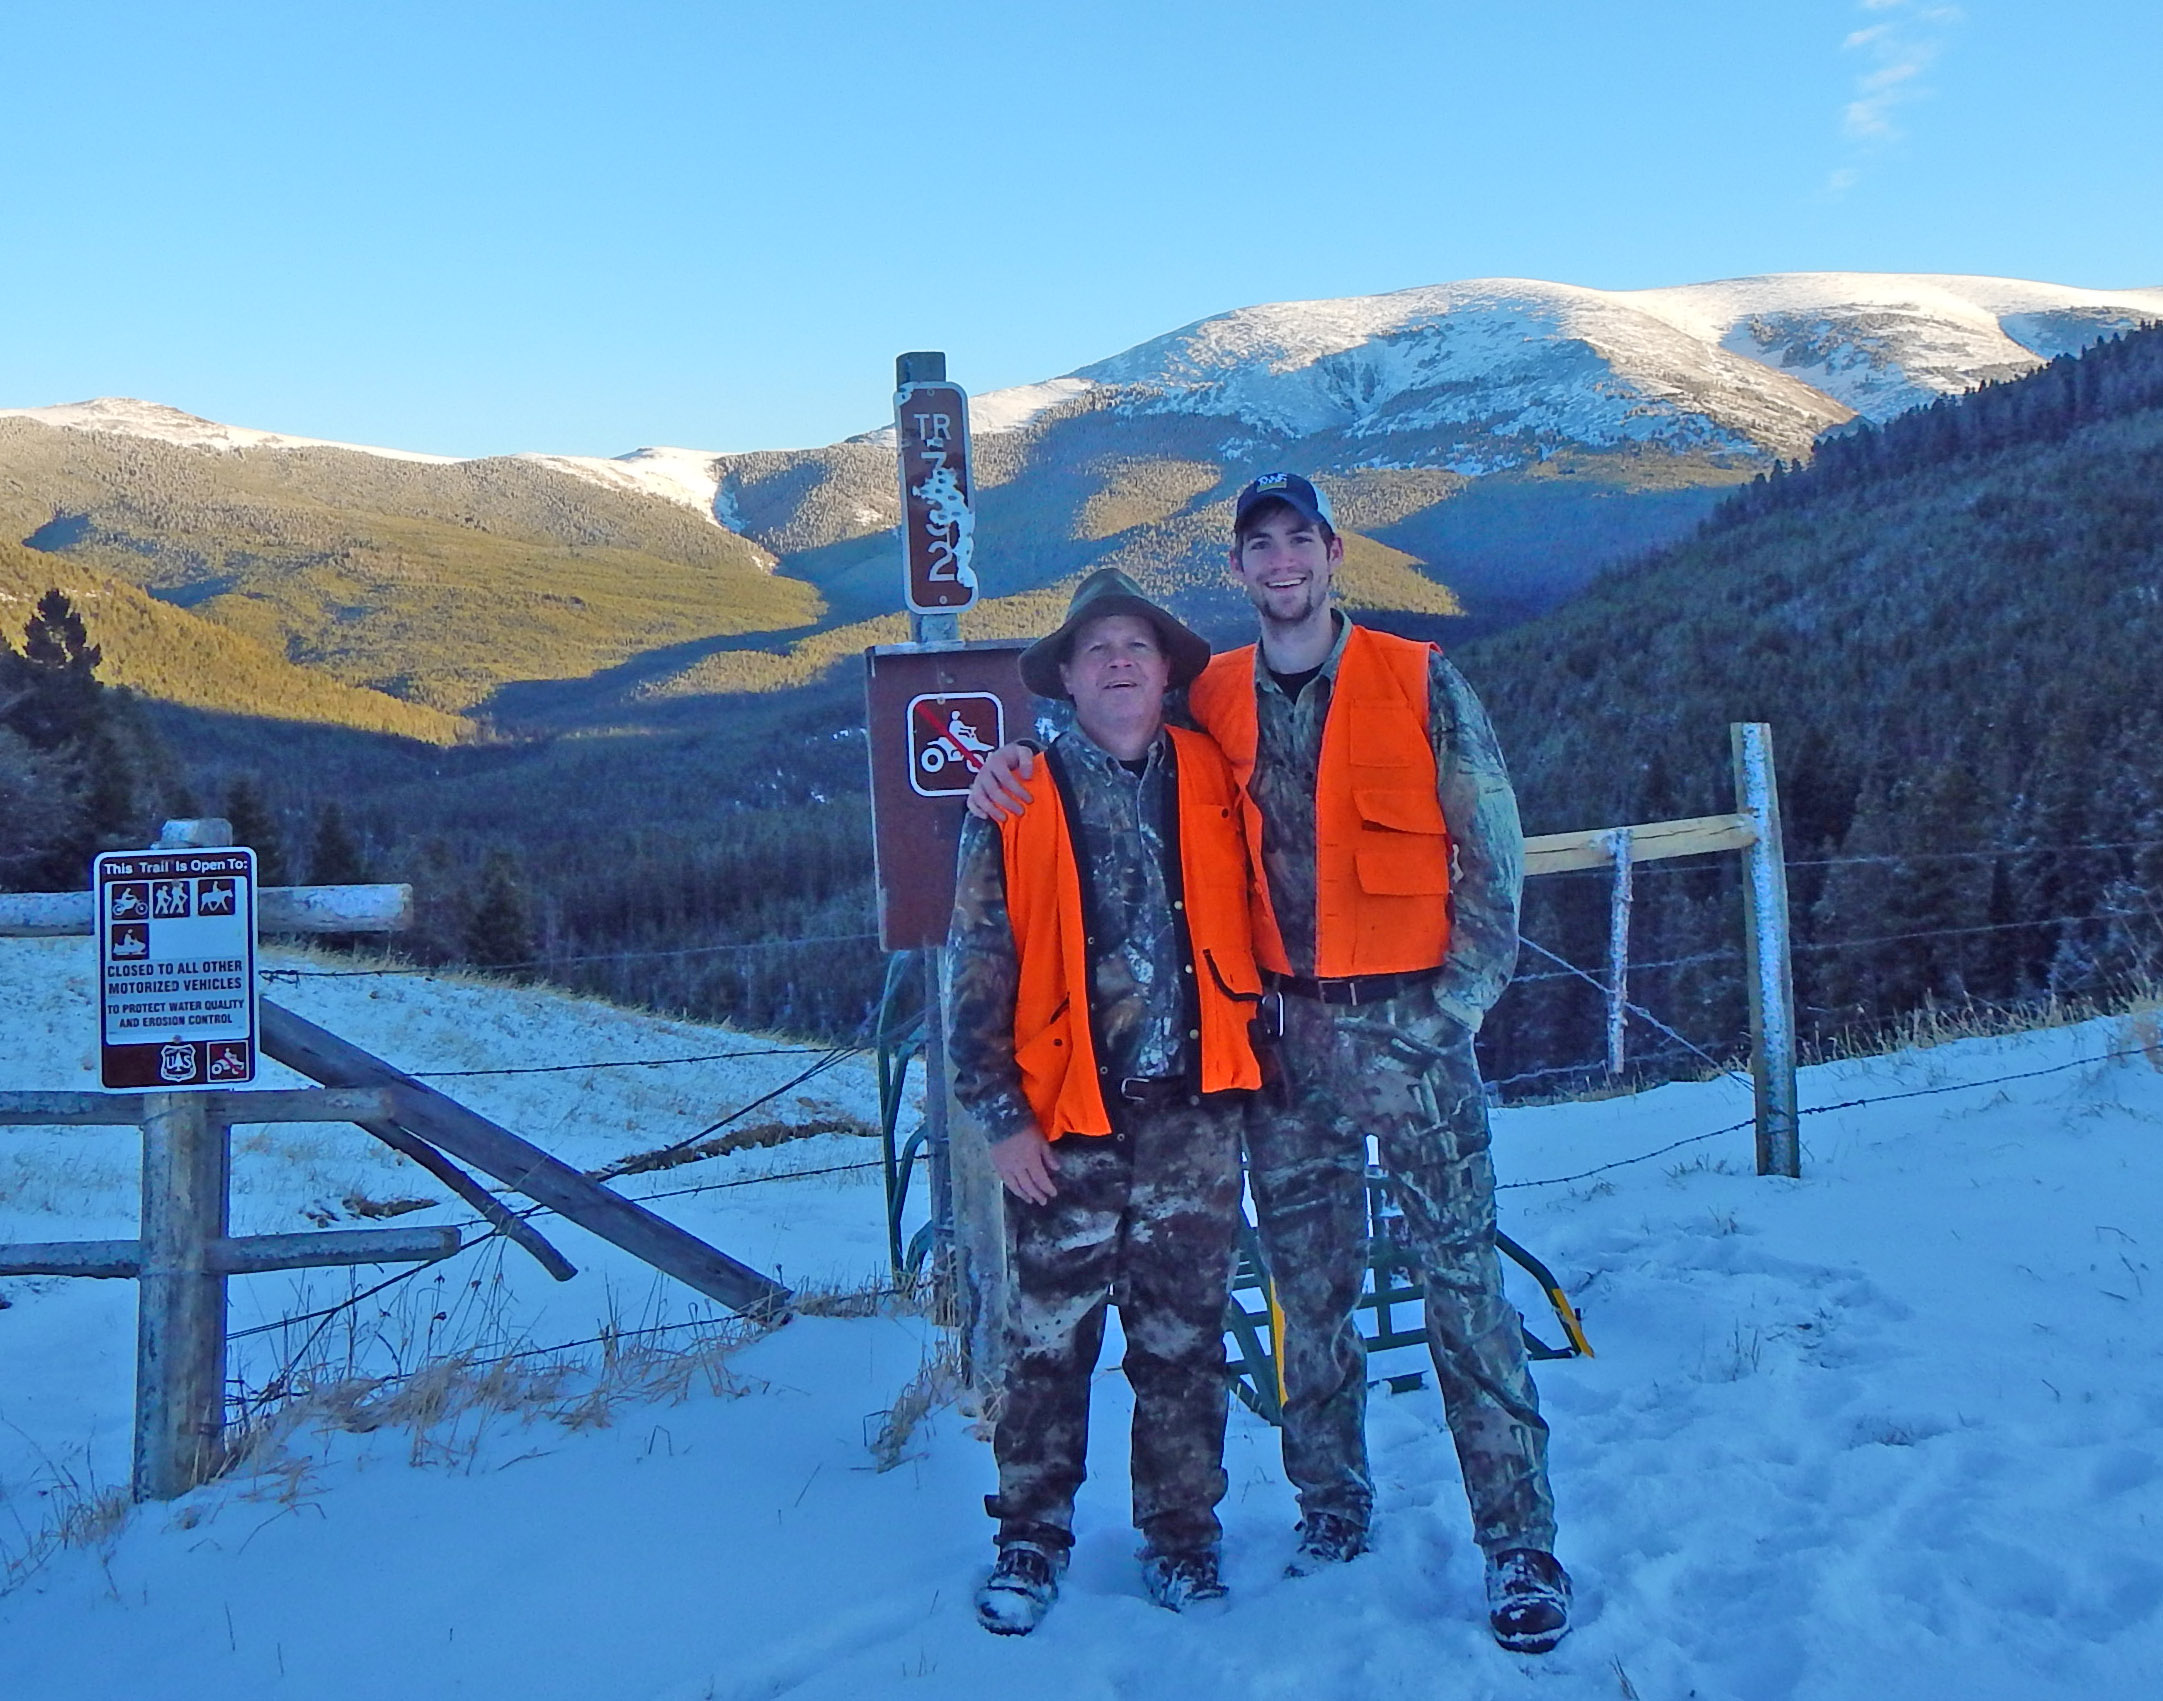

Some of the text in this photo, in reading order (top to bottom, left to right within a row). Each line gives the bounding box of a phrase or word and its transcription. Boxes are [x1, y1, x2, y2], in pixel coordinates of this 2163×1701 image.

[913, 413, 952, 440] TR
[104, 858, 248, 874] This Trail Is Open To:
[107, 959, 242, 978] CLOSED TO ALL OTHER
[108, 977, 242, 995] MOTORIZED VEHICLES
[108, 999, 245, 1015] TO PROTECT WATER QUALITY
[119, 1013, 233, 1028] AND EROSION CONTROL
